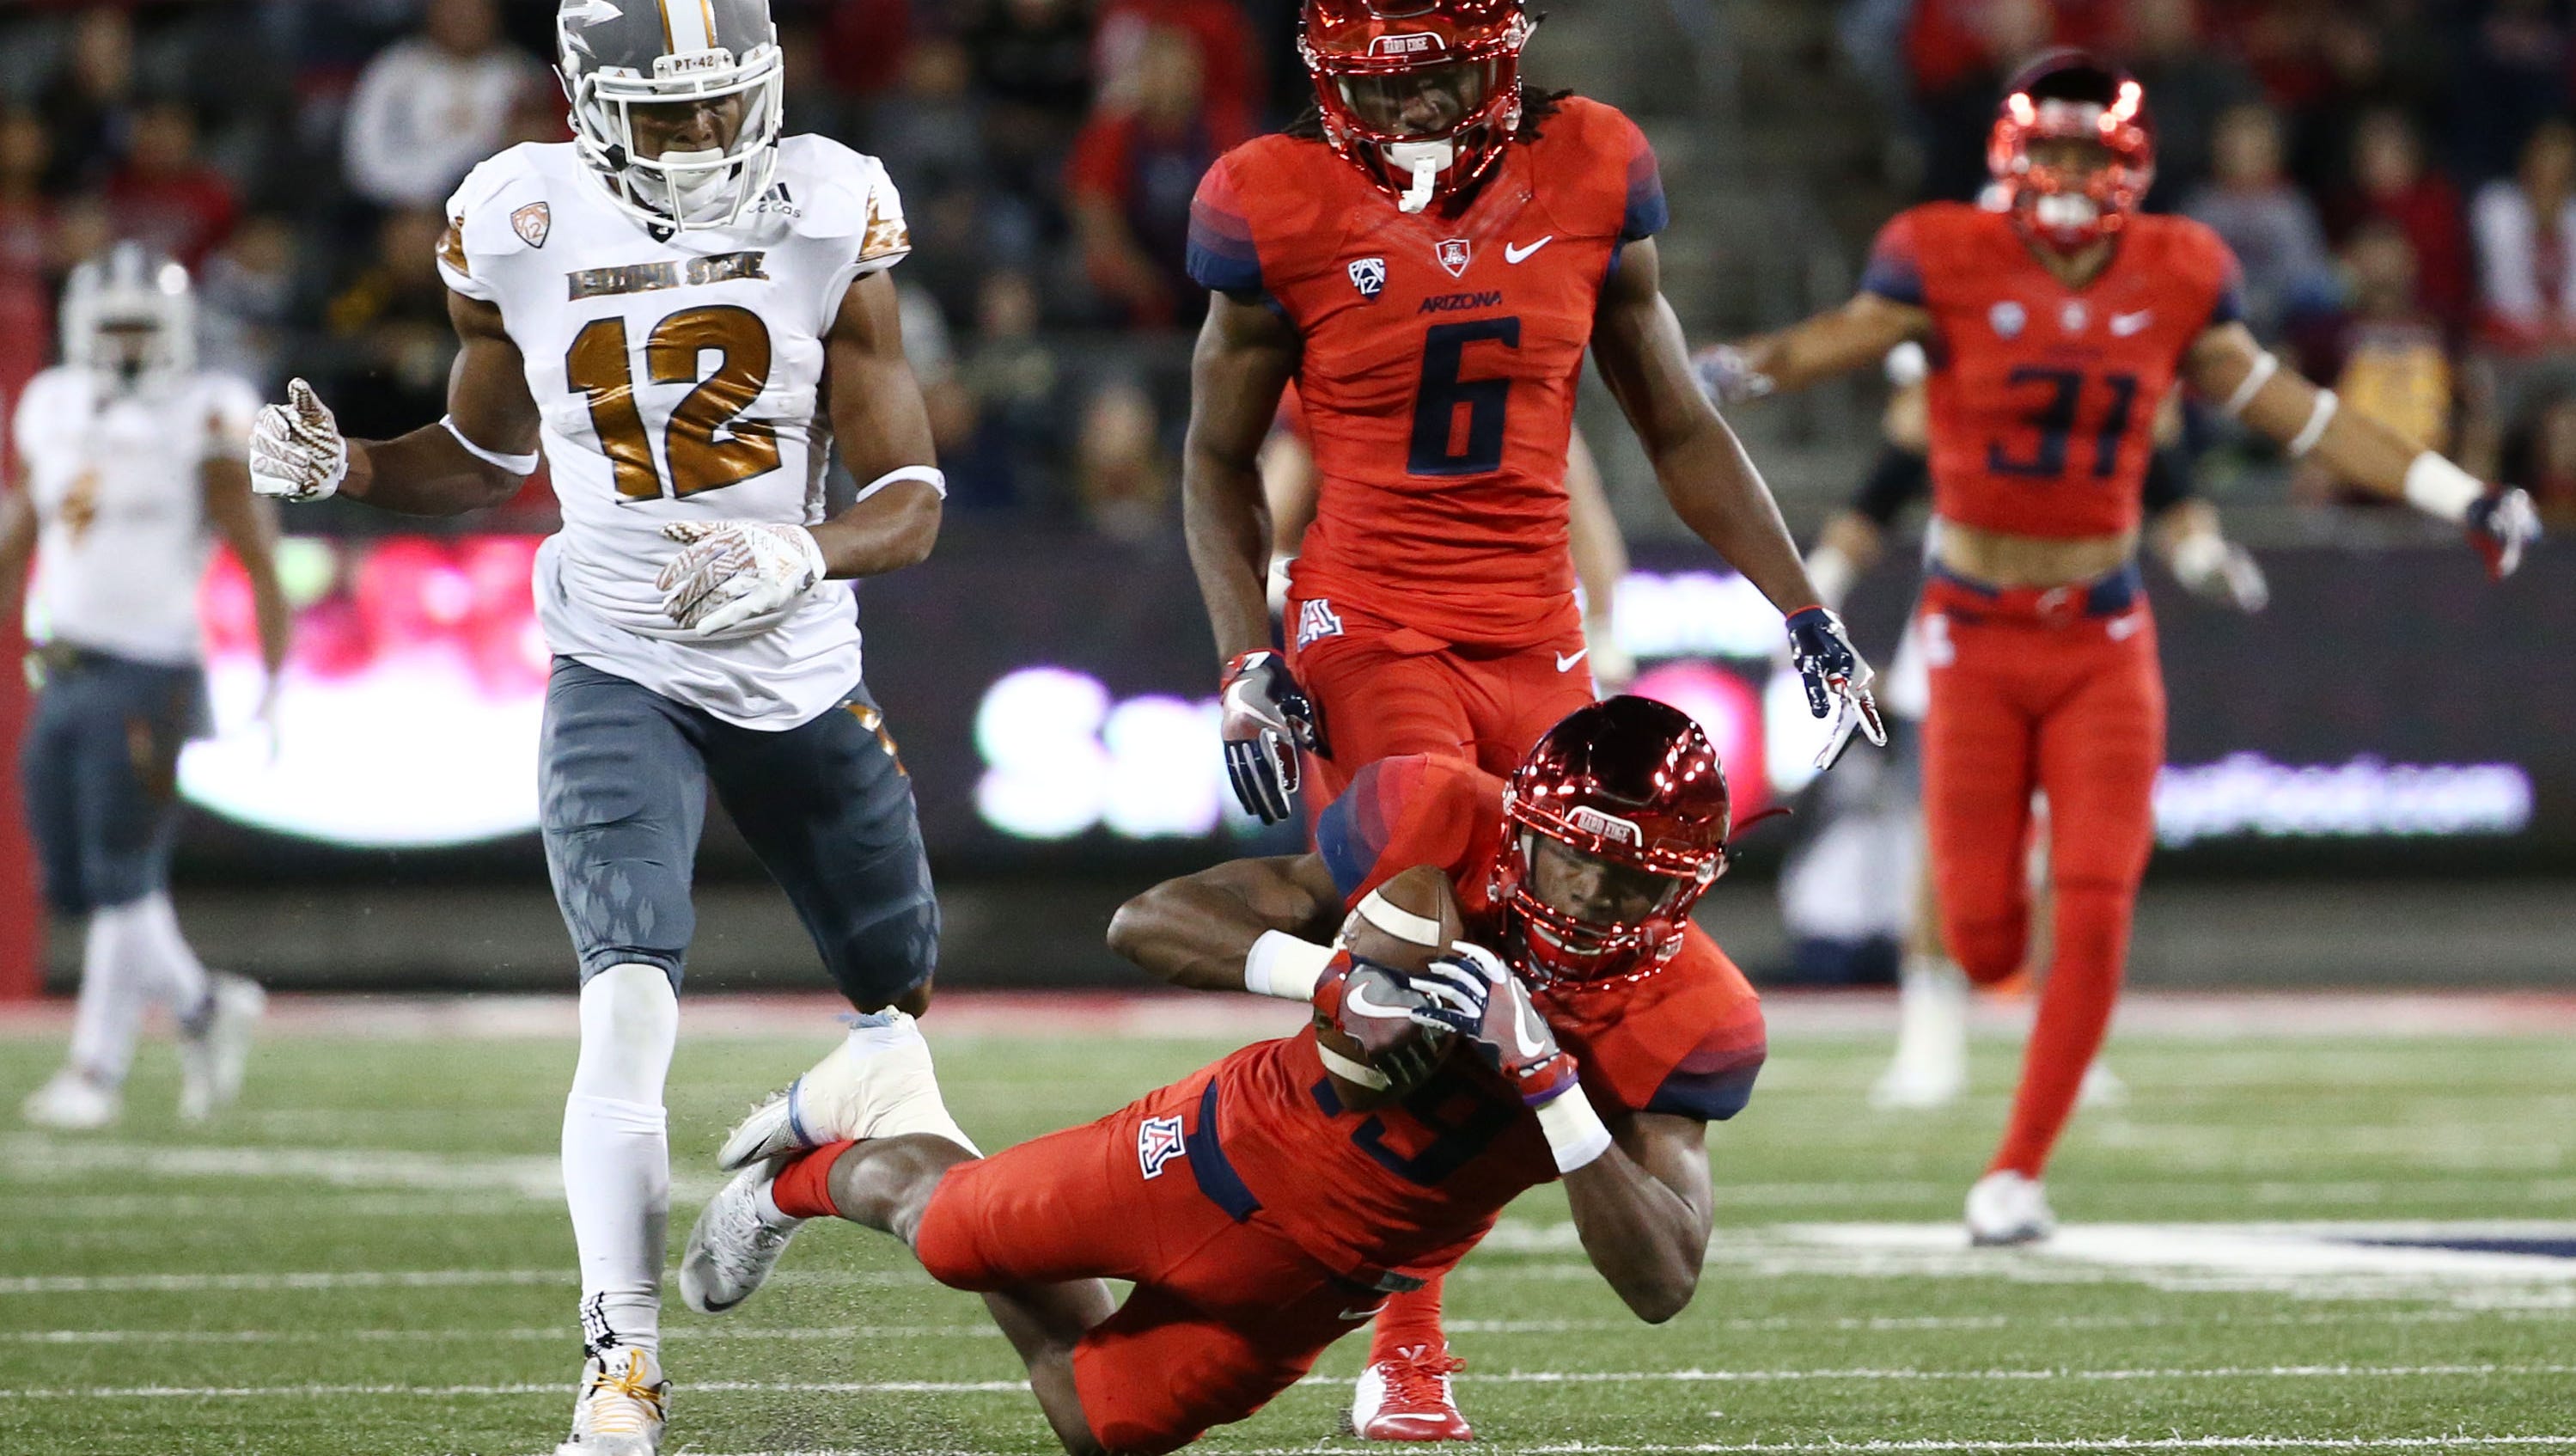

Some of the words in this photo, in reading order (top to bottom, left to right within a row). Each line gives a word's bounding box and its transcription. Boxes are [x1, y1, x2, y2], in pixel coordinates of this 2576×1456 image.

[525, 223, 544, 240] 12
[1348, 257, 1386, 287] PAC
[1360, 276, 1381, 295] 12
[1418, 291, 1502, 314] ARIZONA
[565, 304, 782, 505] 12
[1407, 315, 1521, 476] 6
[1988, 364, 2138, 480] 31
[1138, 1115, 1186, 1180] A
